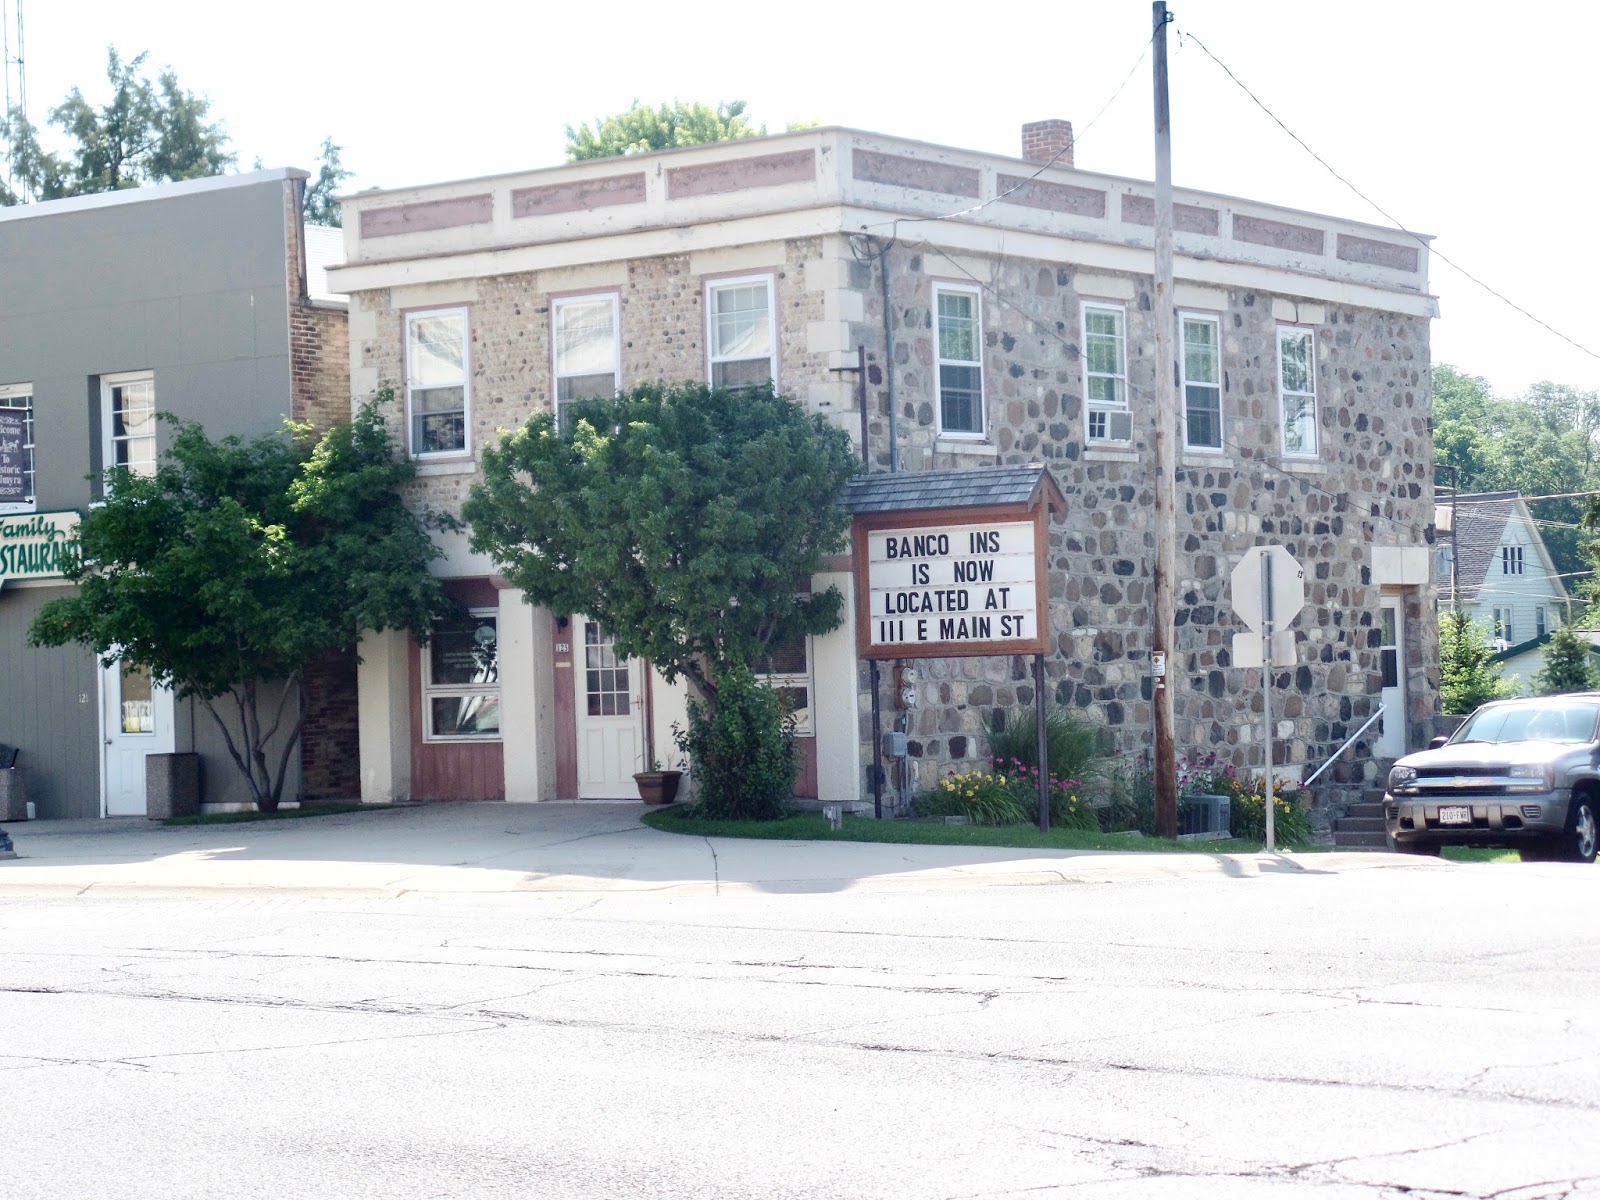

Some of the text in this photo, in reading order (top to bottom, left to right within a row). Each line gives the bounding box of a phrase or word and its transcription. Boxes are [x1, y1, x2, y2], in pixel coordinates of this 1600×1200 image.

[0, 464, 21, 474] storic
[1, 454, 10, 464] To
[886, 531, 1000, 559] BANCO INS
[912, 560, 994, 585] IS NOW
[885, 587, 1010, 614] LOCATED AT
[917, 619, 927, 641] E
[939, 616, 991, 640] MAIN
[1000, 615, 1024, 638] ST
[556, 643, 569, 652] 125
